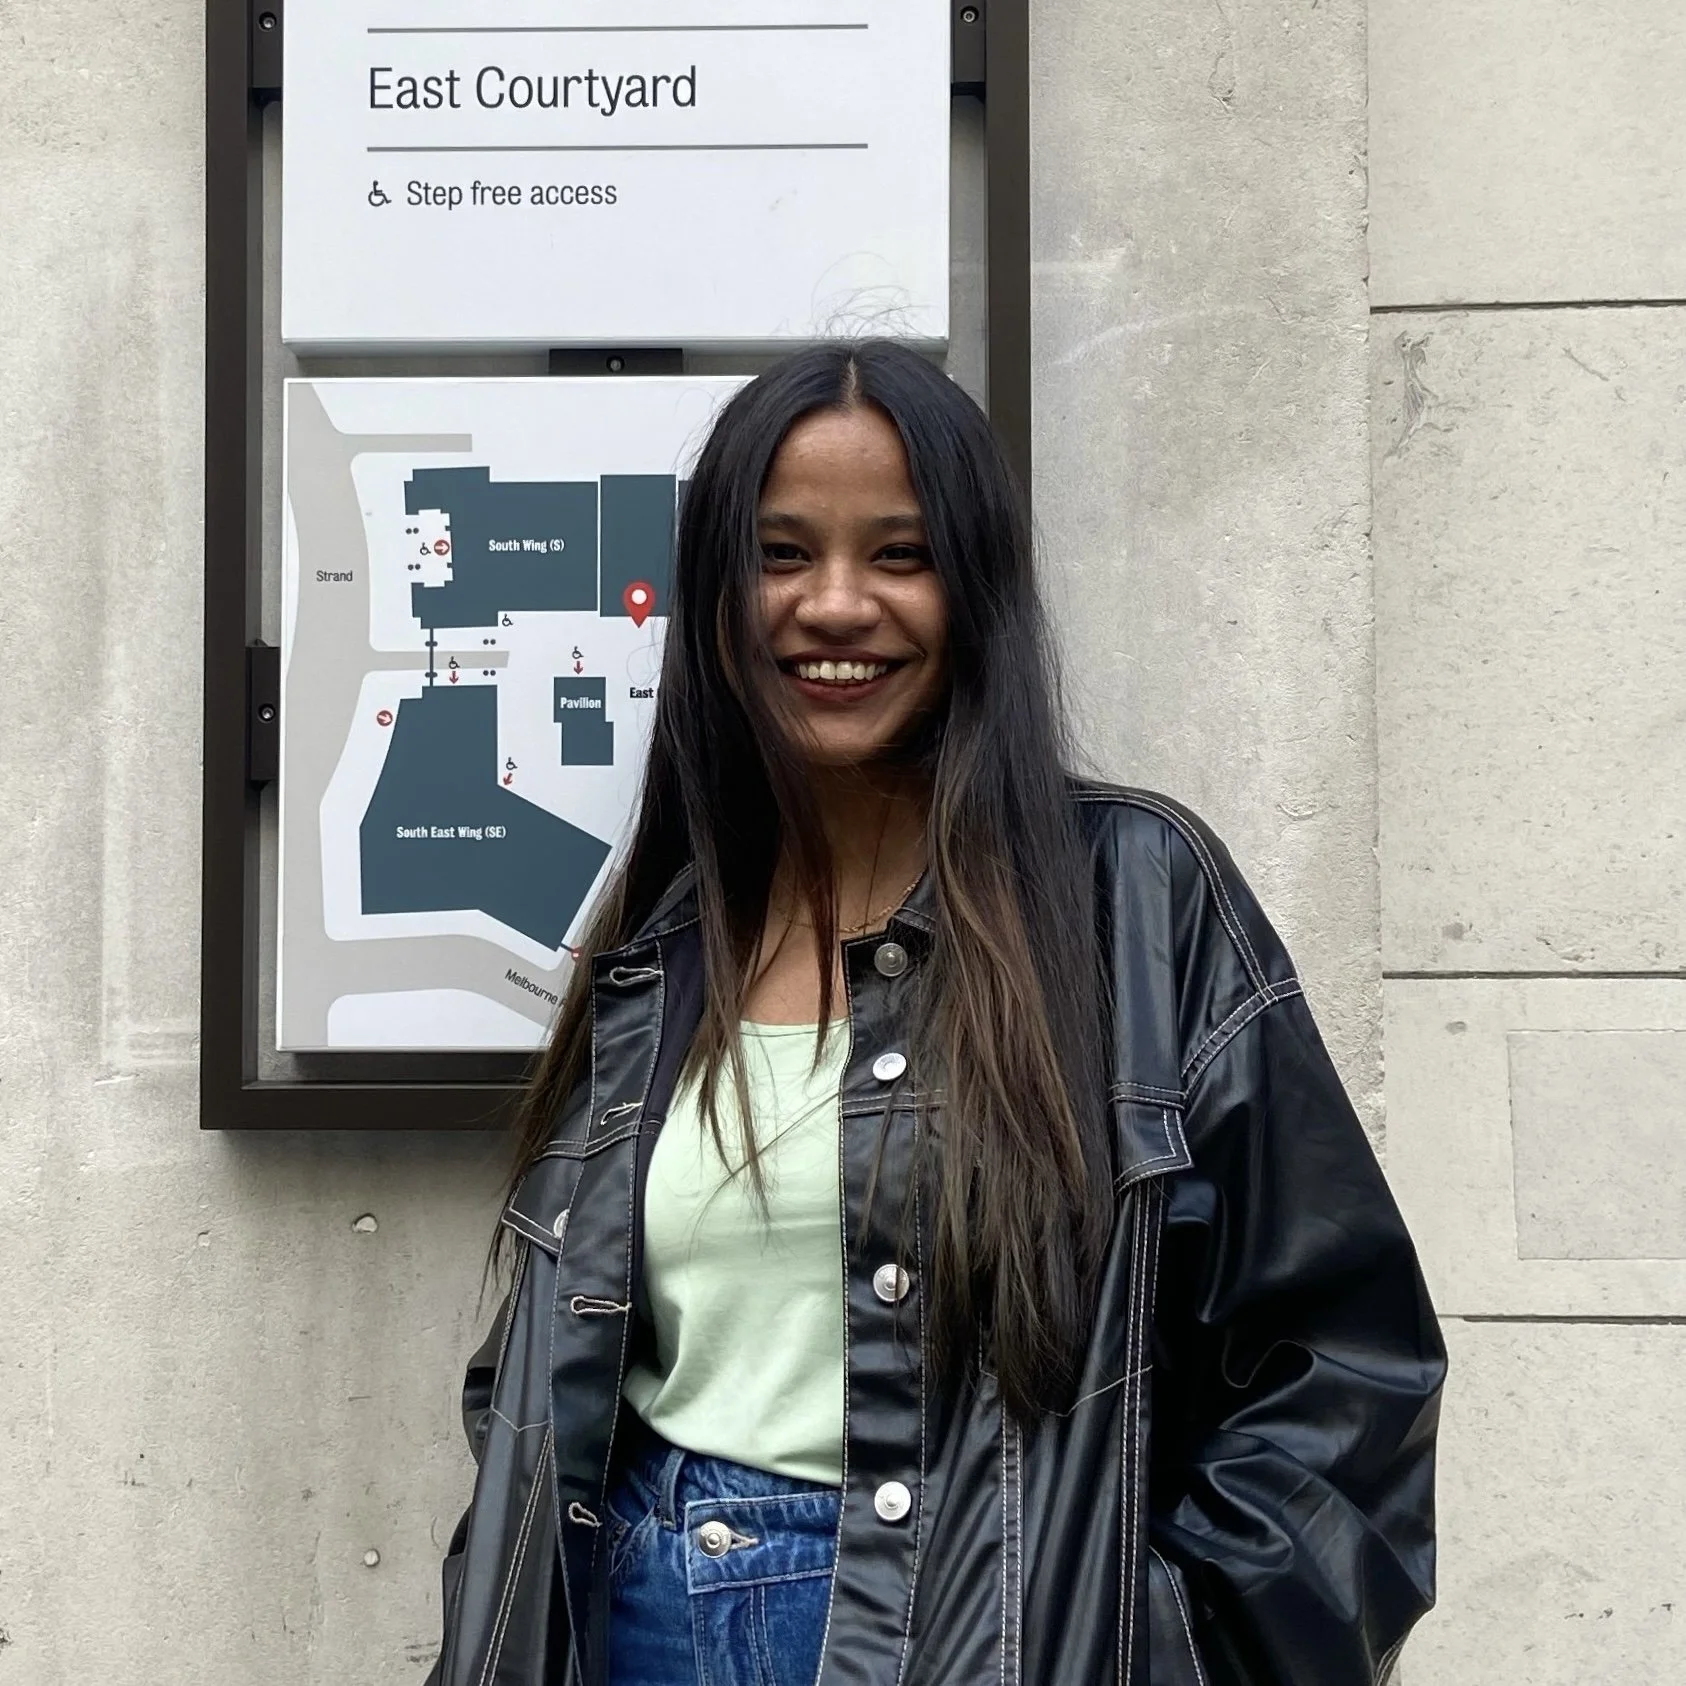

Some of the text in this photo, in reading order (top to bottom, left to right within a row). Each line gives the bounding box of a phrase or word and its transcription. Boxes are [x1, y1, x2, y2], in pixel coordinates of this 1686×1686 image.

[369, 65, 697, 117] East Courtyard
[407, 180, 617, 211] Step free access
[488, 539, 565, 554] South Wing (S)
[316, 570, 353, 583] Strand
[629, 686, 654, 699] East
[560, 696, 603, 710] Pavilion
[396, 826, 507, 841] South East Wing (SE)
[505, 968, 559, 1005] Melbourne
